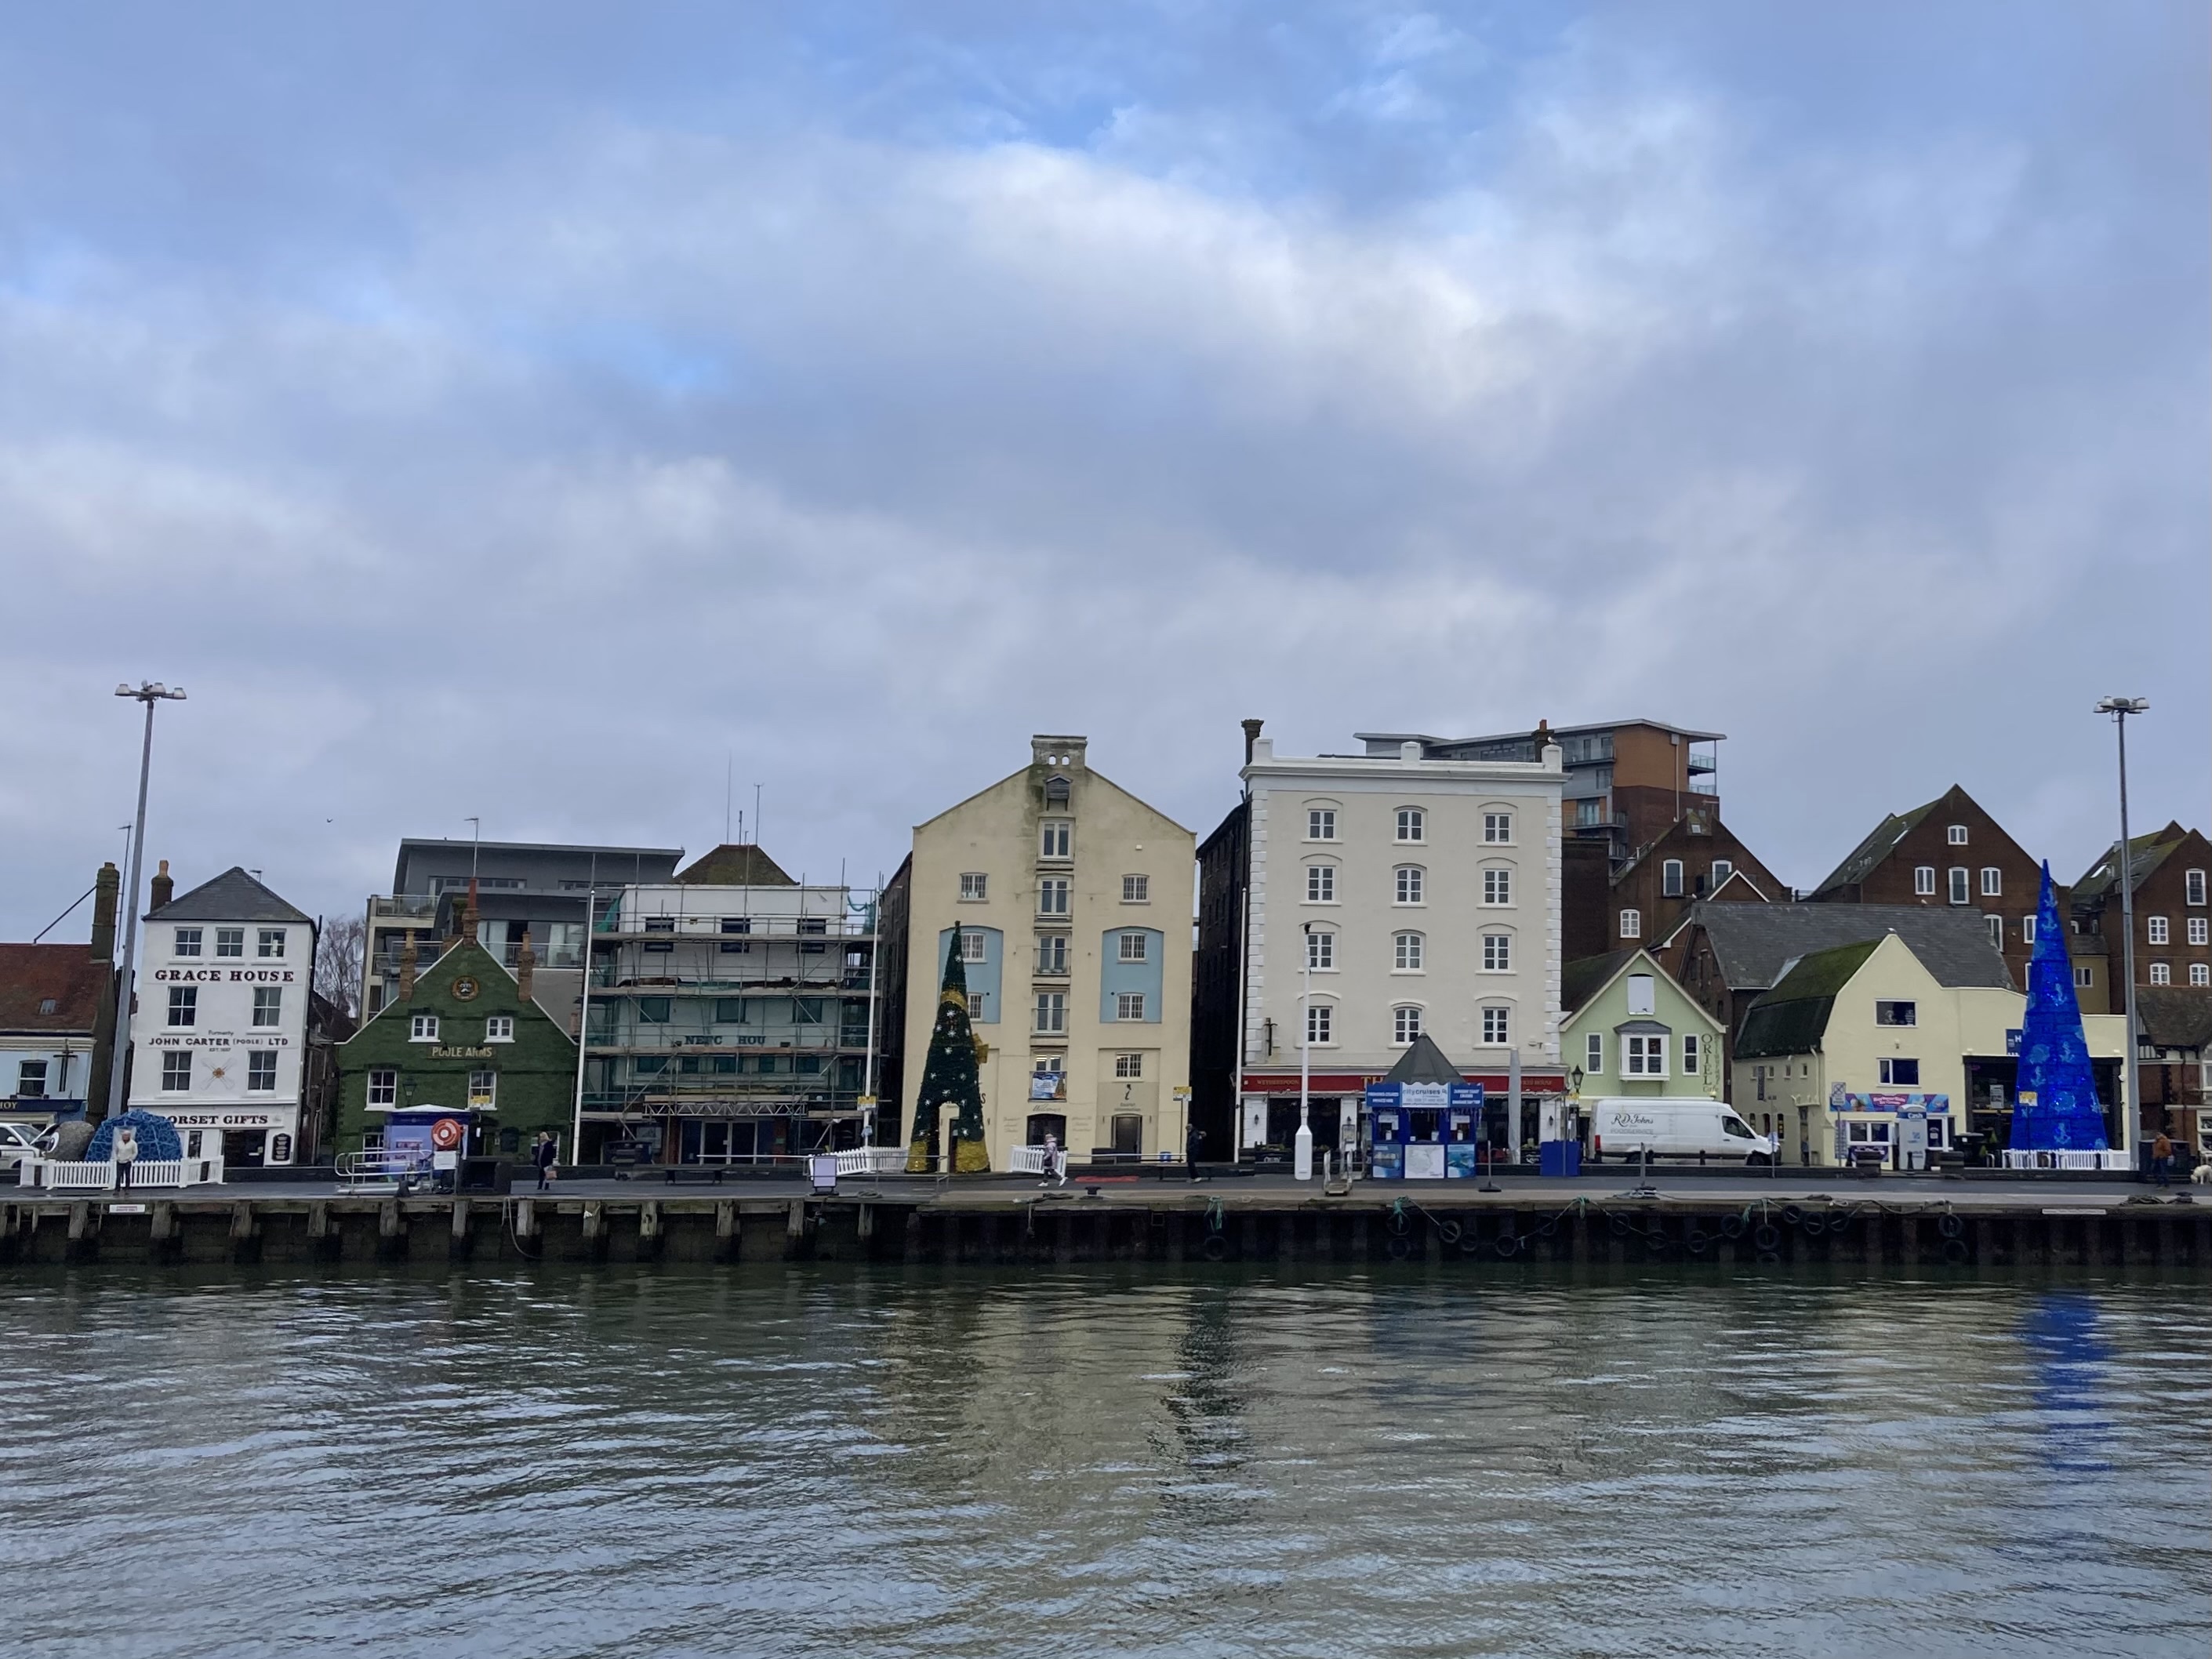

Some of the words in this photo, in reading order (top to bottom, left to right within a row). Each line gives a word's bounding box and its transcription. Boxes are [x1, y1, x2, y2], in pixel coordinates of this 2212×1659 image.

[155, 970, 221, 981] GRACE
[230, 971, 294, 982] HOUSE
[185, 1037, 231, 1046] CARTER
[268, 1037, 289, 1046] LTD
[432, 1047, 463, 1057] POOLE
[466, 1047, 492, 1057] ARMS
[1701, 1033, 1713, 1086] ORIEL
[168, 1116, 219, 1124] ORSET
[223, 1116, 268, 1124] GIFTS
